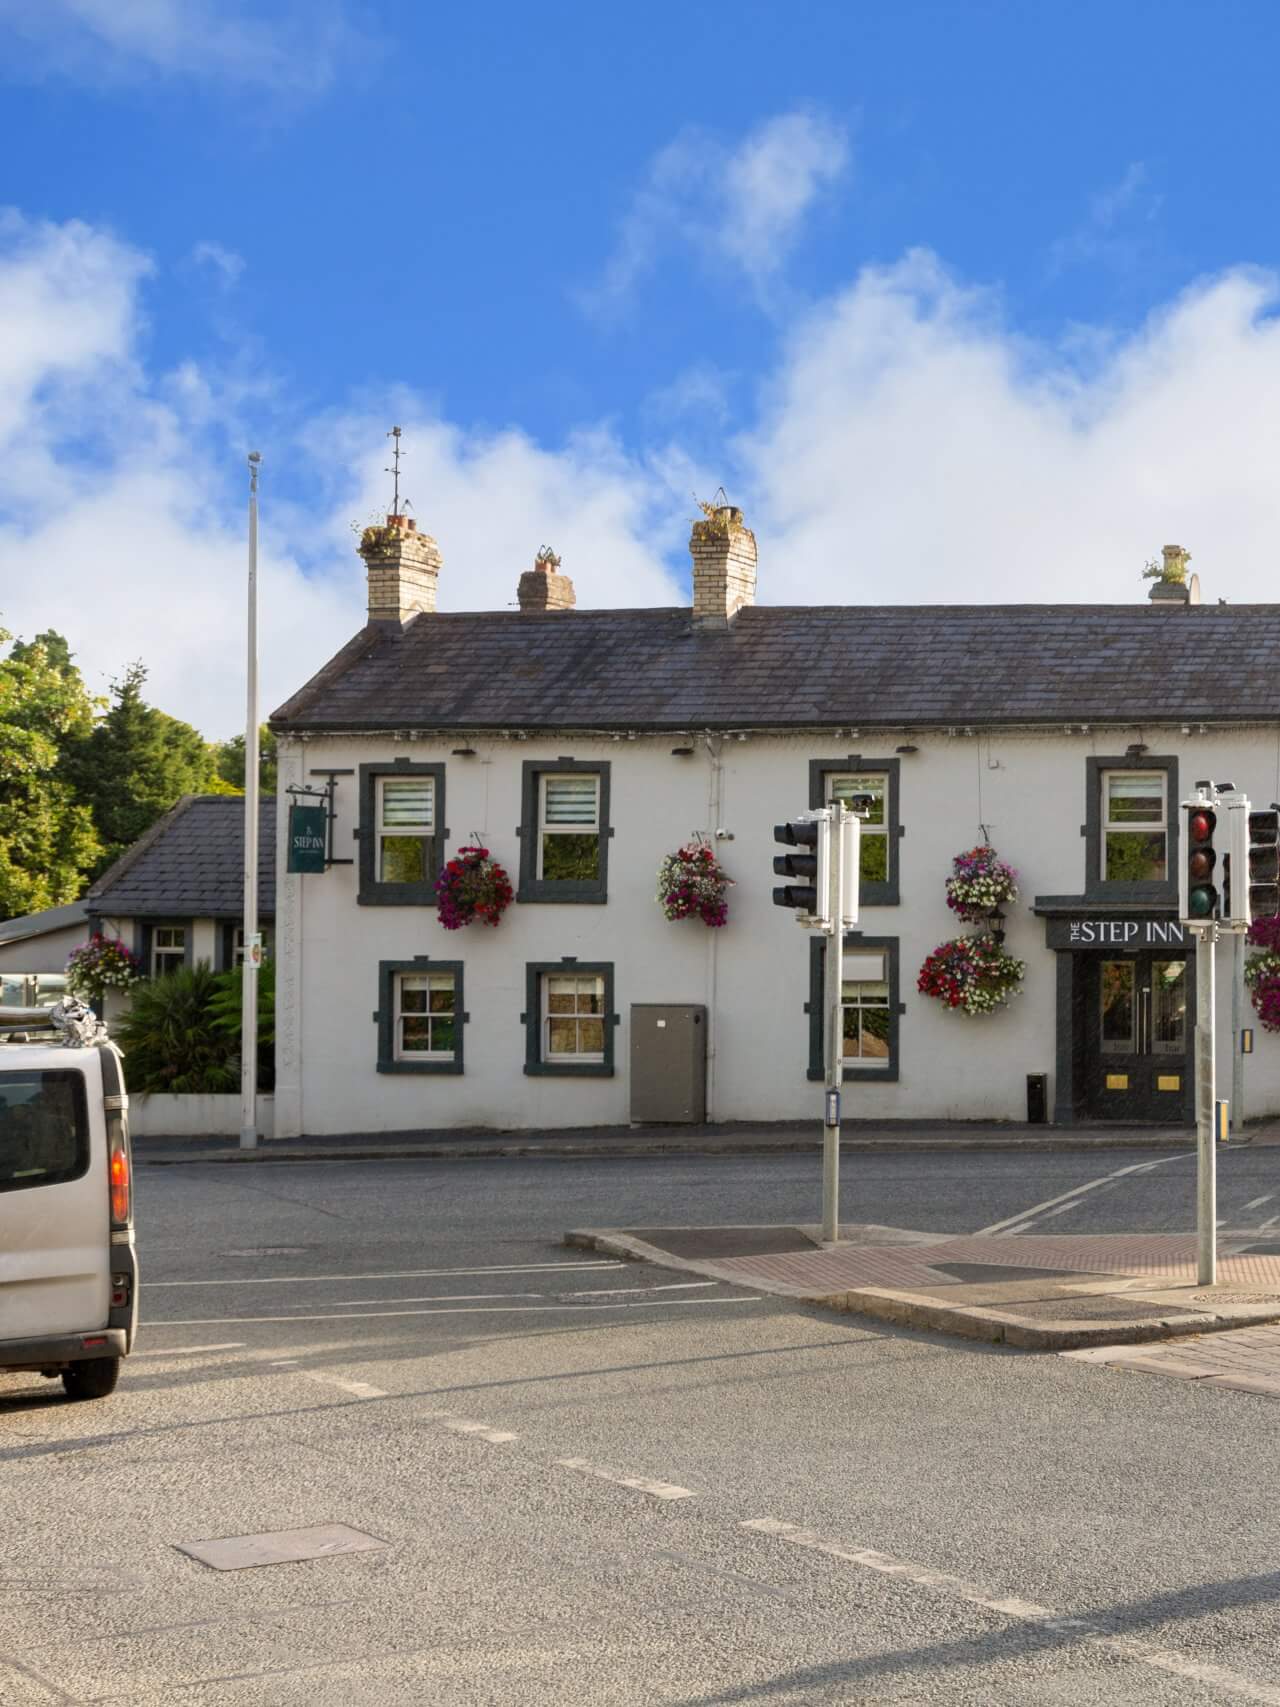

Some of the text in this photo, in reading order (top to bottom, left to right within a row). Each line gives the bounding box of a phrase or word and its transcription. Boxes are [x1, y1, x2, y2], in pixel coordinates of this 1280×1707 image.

[294, 837, 312, 848] STEP
[1070, 921, 1184, 942] THE STEP INN
